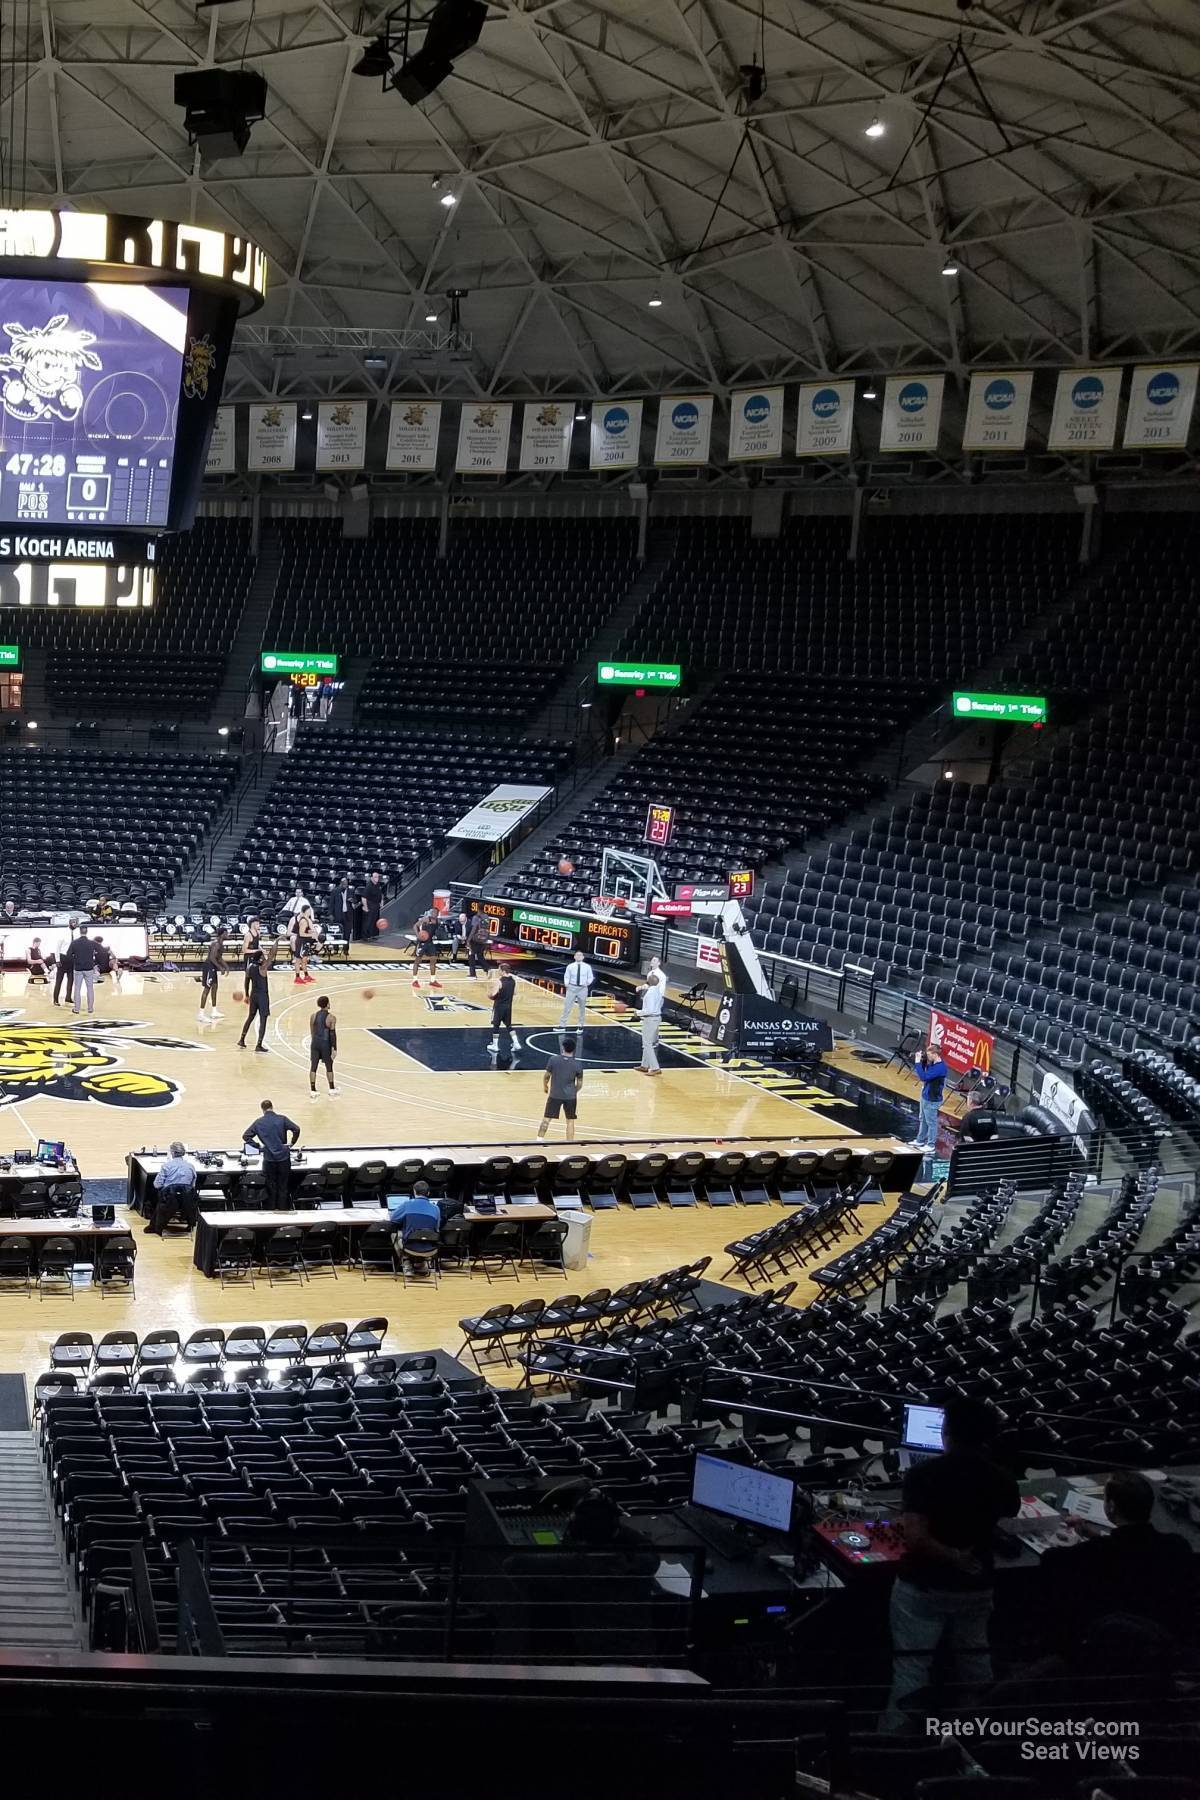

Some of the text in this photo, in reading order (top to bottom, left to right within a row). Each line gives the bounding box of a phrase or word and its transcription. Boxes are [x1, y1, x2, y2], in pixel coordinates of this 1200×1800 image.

[1074, 391, 1103, 401] NCAA
[1149, 388, 1178, 398] NCAA
[746, 408, 769, 417] NCAA
[674, 415, 698, 425] NCAA
[898, 432, 923, 442] 2010
[982, 430, 1008, 441] 2011
[1068, 430, 1097, 440] 2012
[1144, 427, 1171, 438] 2013
[744, 442, 768, 451] 2008
[812, 437, 837, 447] 2009
[670, 447, 696, 457] 2007
[262, 455, 281, 464] 2008
[330, 454, 350, 463] 2013
[401, 454, 421, 464] 2015
[471, 457, 492, 466] 2016
[534, 455, 555, 465] 2017
[6, 452, 66, 477] 47:28
[82, 478, 96, 501] 0
[18, 493, 48, 511] POS
[15, 537, 62, 557] KOCH
[64, 538, 115, 558] ARENA
[316, 660, 333, 668] Title
[290, 673, 317, 686] 4:28
[657, 671, 677, 680] Title
[1019, 704, 1043, 715] Title
[734, 883, 747, 893] 23
[471, 902, 506, 916] SCKERS
[528, 914, 574, 928] DELTA DENTAL
[520, 925, 560, 946] 47:28
[588, 922, 629, 939] BEARCATS
[609, 940, 618, 957] 0
[744, 1020, 819, 1031] KANSAS STAR
